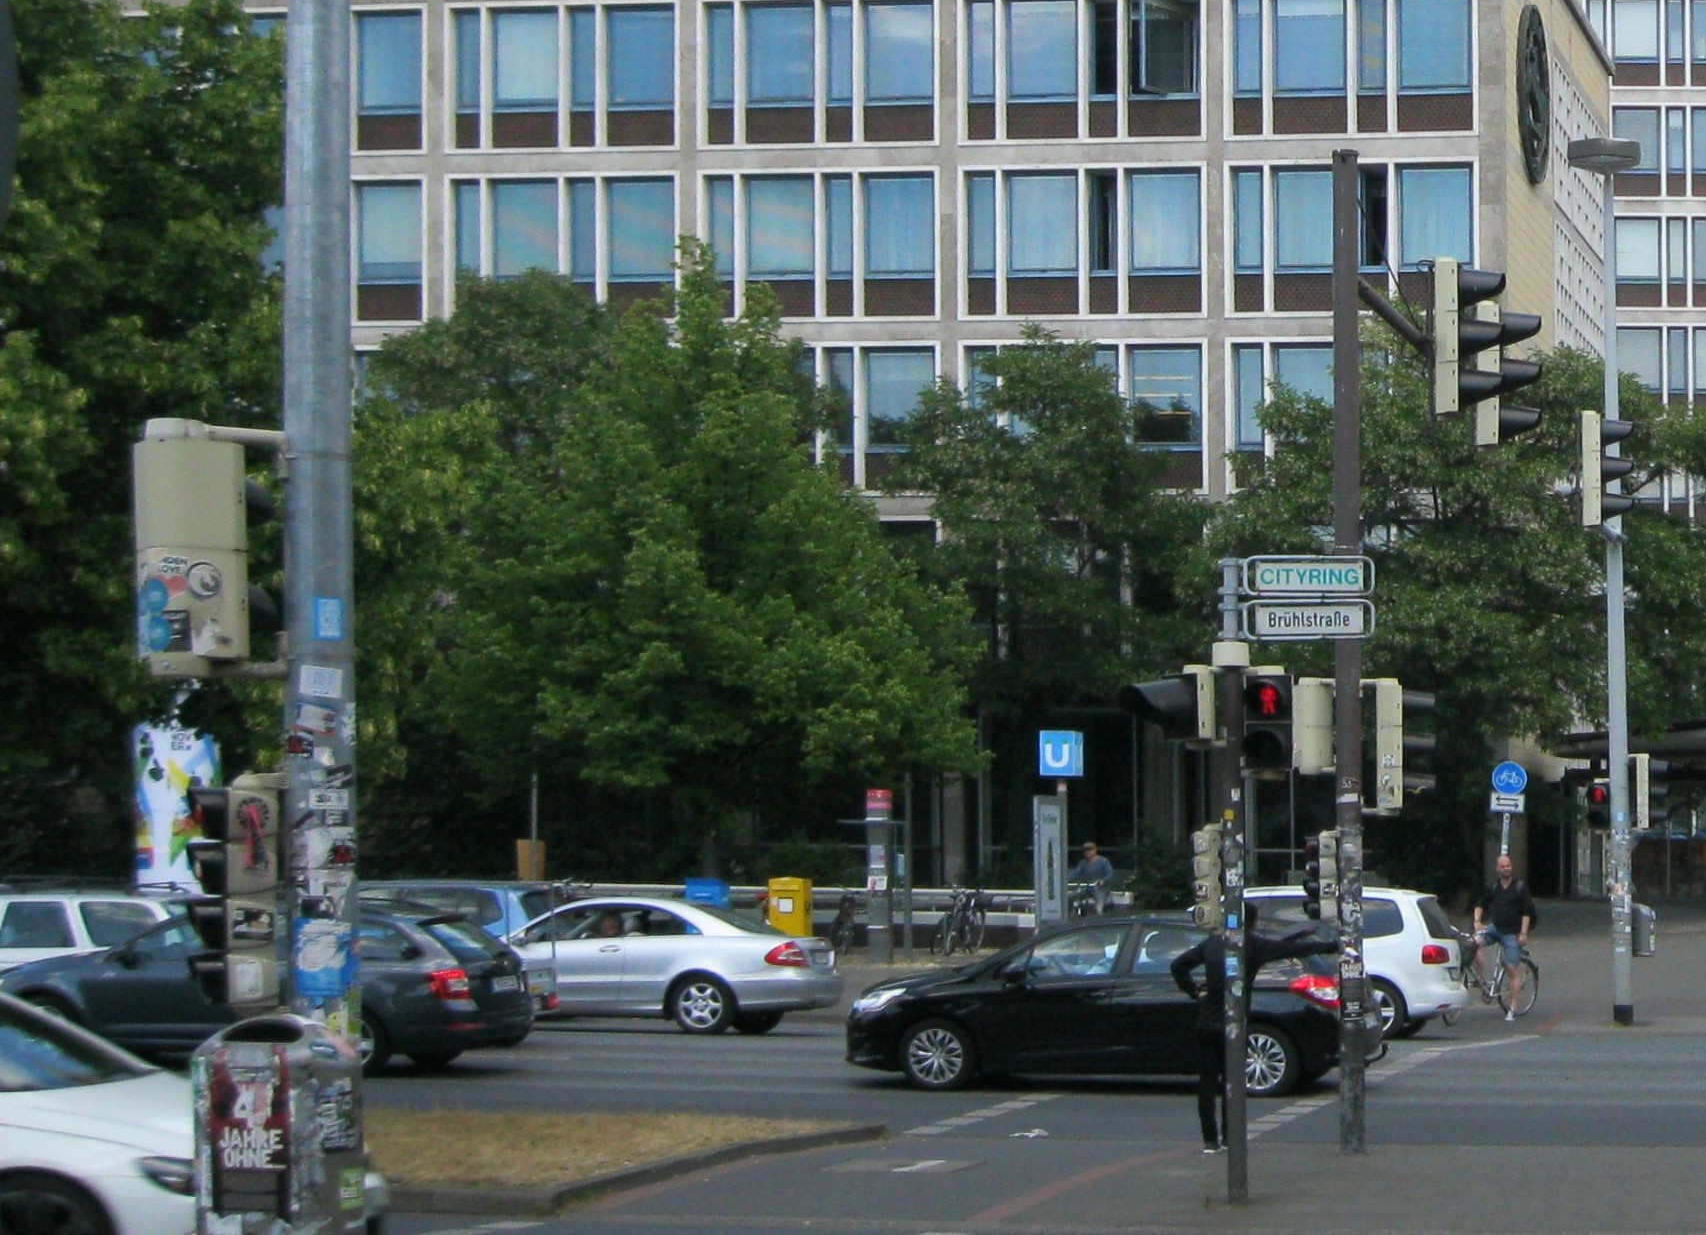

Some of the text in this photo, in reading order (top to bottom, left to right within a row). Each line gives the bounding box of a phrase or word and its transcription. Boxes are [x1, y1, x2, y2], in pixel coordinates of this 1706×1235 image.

[1259, 568, 1359, 585] CITYRING
[1268, 611, 1351, 628] Brühlstraße
[219, 1126, 284, 1150] JAHRE
